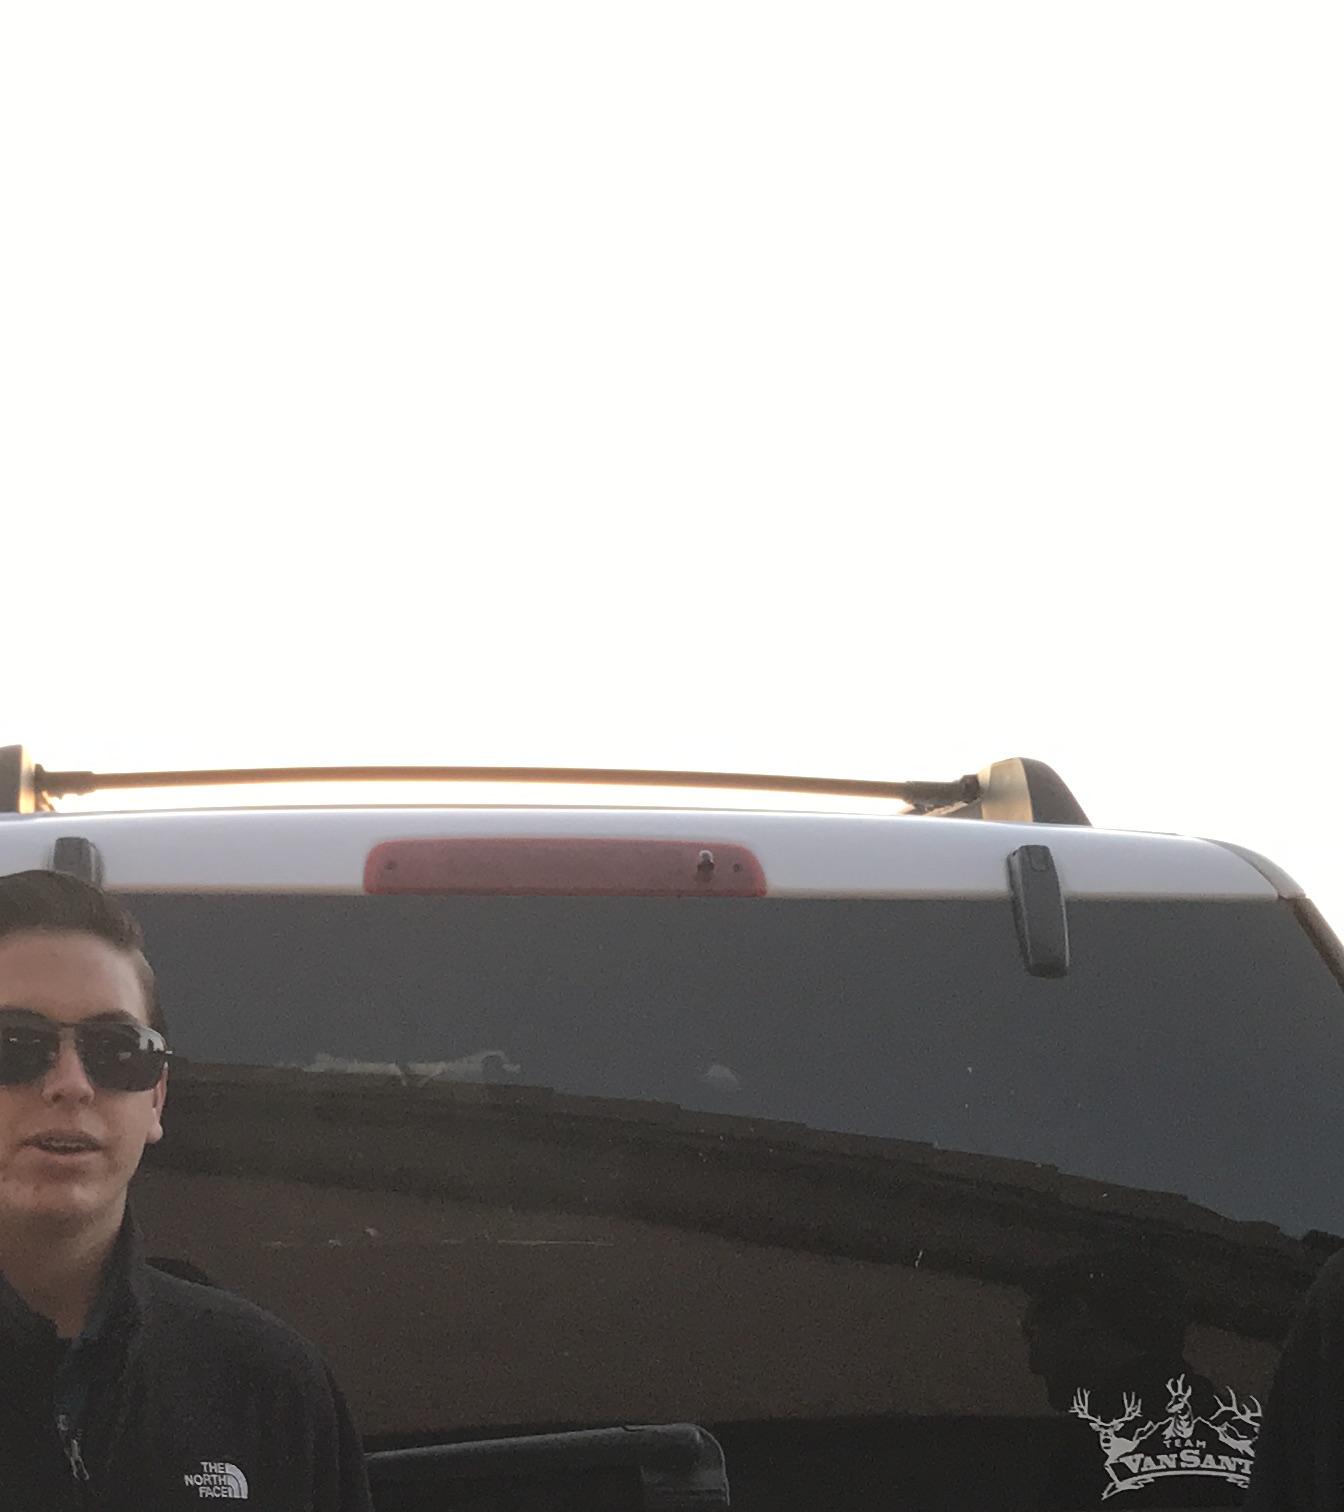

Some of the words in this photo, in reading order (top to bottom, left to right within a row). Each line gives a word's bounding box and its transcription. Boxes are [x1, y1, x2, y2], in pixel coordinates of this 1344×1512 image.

[1162, 1439, 1206, 1449] TEAM
[200, 1461, 226, 1473] THE
[183, 1474, 227, 1487] NORTH
[198, 1486, 228, 1498] FACE
